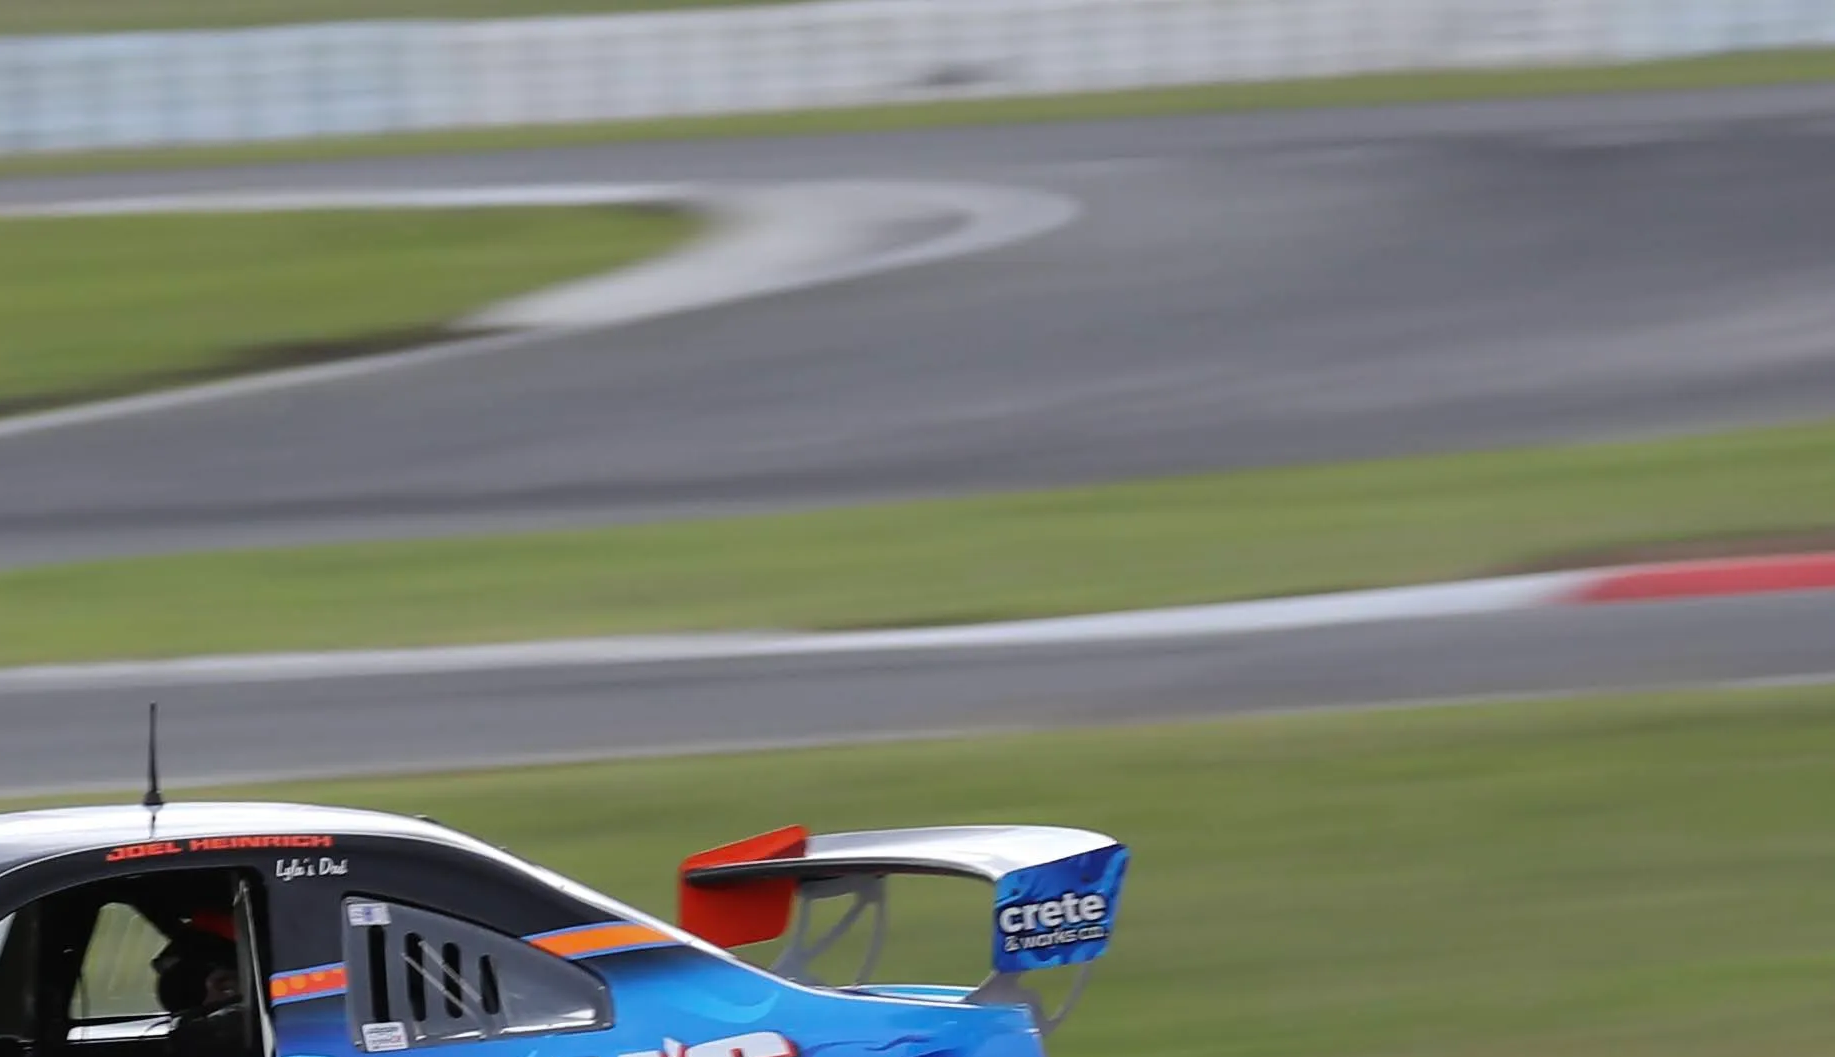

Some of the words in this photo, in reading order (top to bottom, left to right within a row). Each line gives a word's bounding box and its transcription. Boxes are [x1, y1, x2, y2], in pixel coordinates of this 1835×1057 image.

[106, 840, 182, 862] JOEL
[189, 835, 333, 851] HEINRICH
[999, 892, 1106, 933] crete
